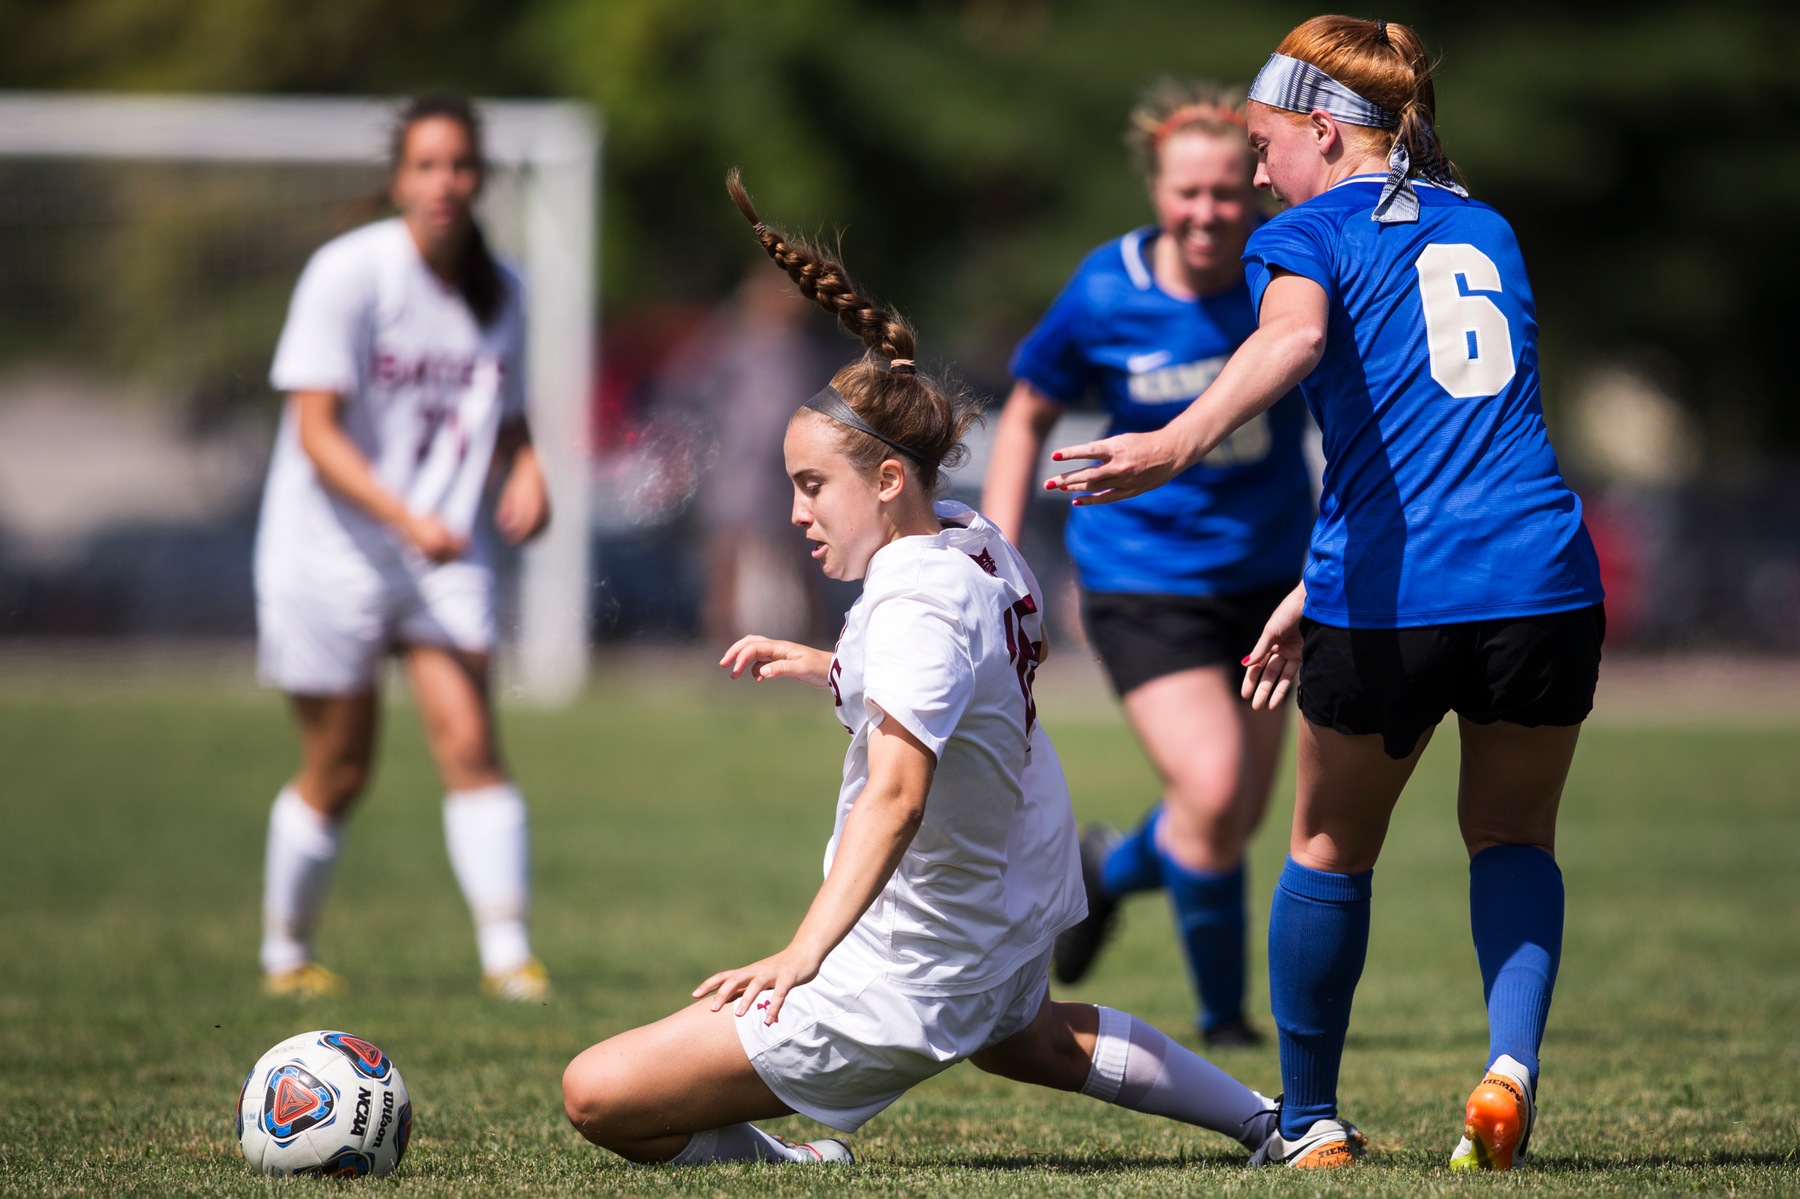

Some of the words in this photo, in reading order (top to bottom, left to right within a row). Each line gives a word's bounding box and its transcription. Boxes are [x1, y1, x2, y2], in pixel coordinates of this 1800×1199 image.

[1415, 243, 1516, 399] 6
[350, 1085, 372, 1137] NCAA
[372, 1090, 394, 1150] Wilson
